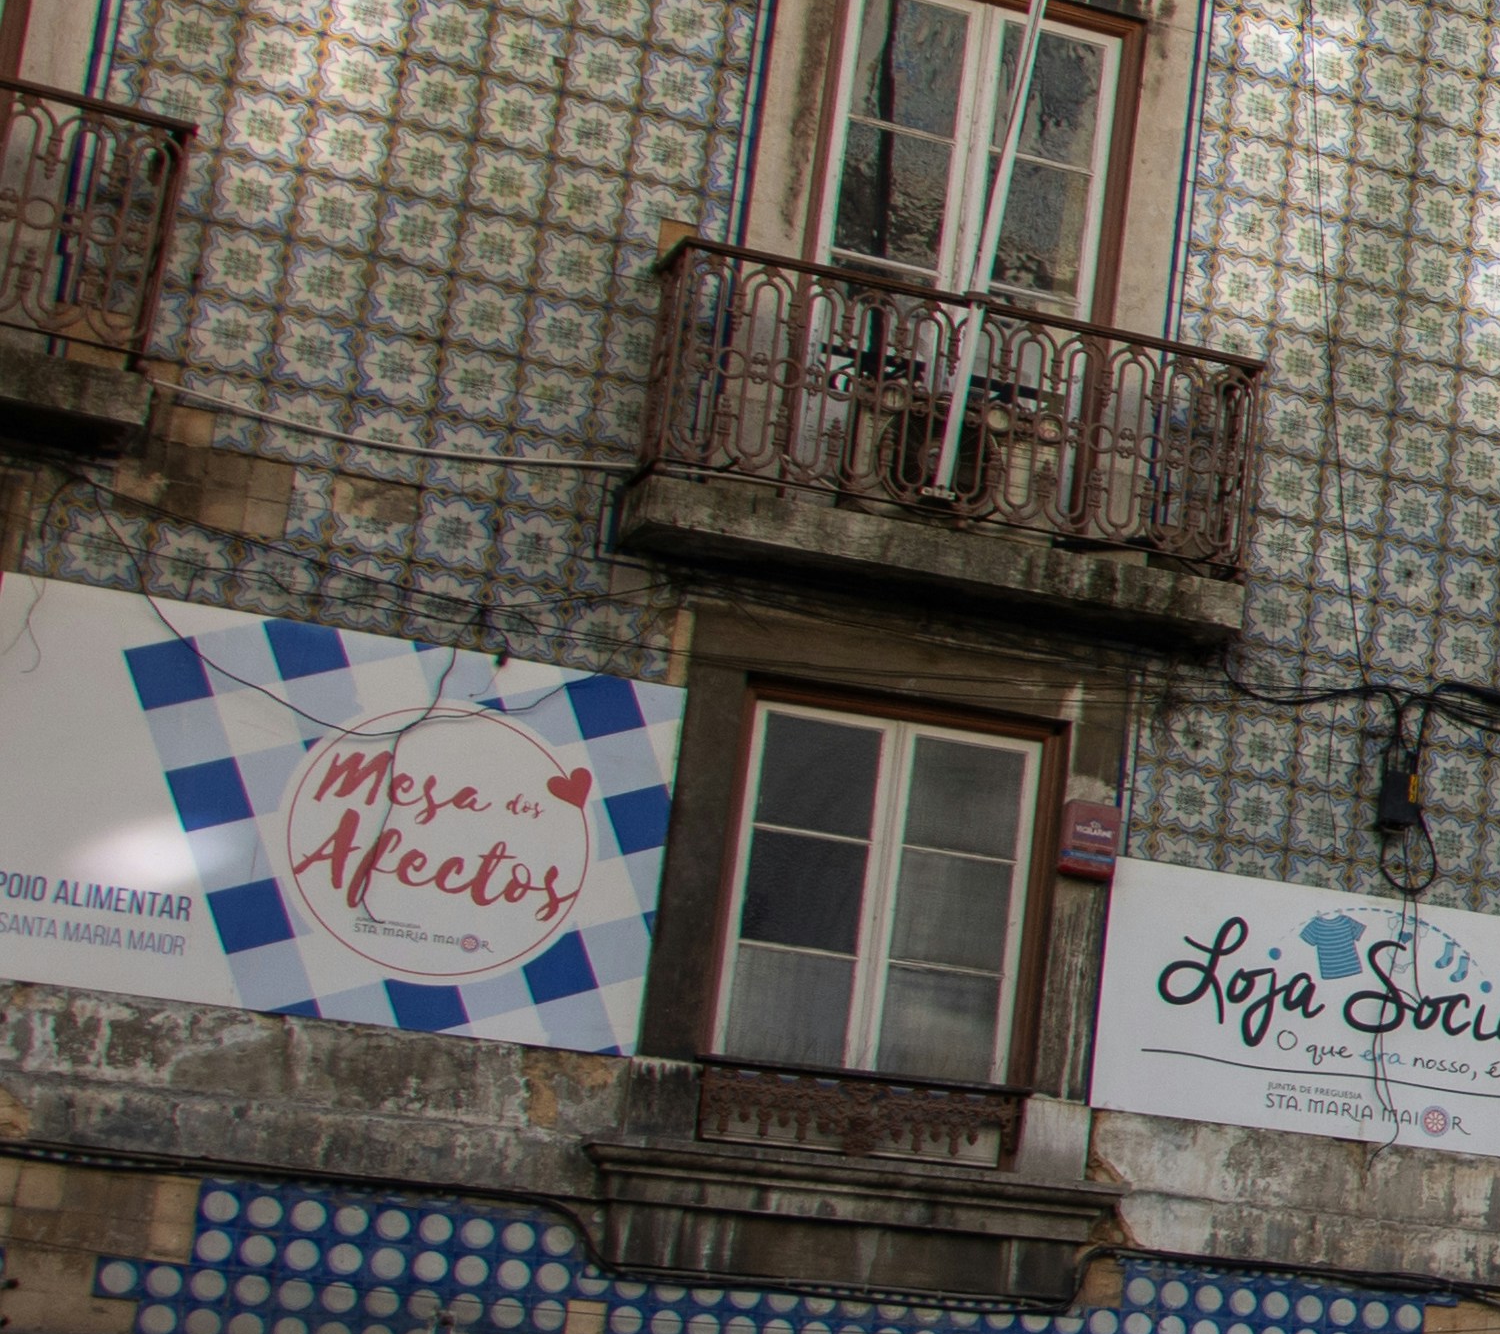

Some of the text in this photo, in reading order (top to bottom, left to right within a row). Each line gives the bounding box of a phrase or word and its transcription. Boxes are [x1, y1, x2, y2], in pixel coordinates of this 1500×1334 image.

[314, 751, 544, 825] Mesa dos
[292, 808, 580, 922] Afectos
[53, 879, 192, 922] ALIMENTAR
[63, 920, 121, 948] MARIA
[127, 929, 186, 956] MAIOR
[383, 927, 429, 943] MARIA
[1158, 917, 1324, 1047] Loja
[1277, 1030, 1298, 1051] O
[1306, 1043, 1353, 1066] que
[1360, 1049, 1405, 1066] era
[1413, 1055, 1478, 1081] nosso,
[1265, 1093, 1302, 1112] STA.
[1308, 1099, 1372, 1122] MARIA
[1266, 1081, 1362, 1100] JUNTA DE FREGUESIA
